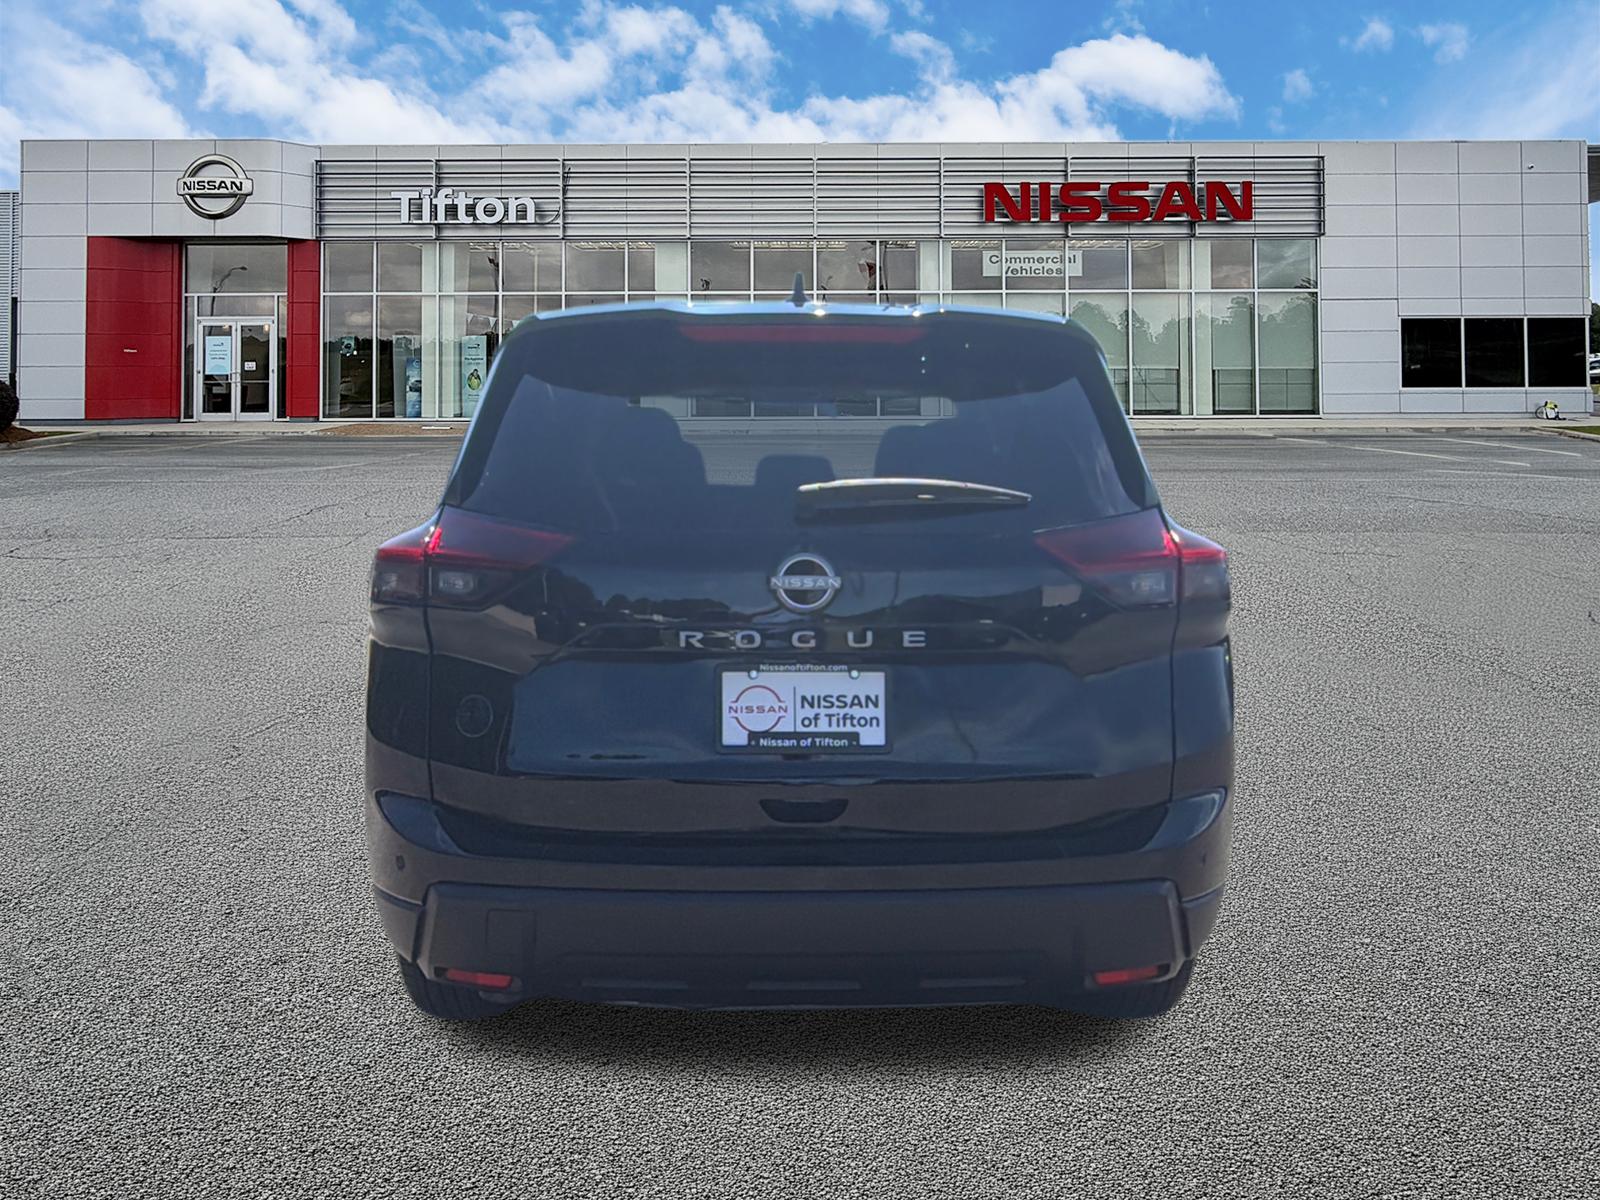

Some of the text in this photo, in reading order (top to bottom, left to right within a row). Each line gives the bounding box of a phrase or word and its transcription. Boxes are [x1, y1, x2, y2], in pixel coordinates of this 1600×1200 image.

[183, 180, 243, 191] NISSAN
[391, 187, 536, 224] Tifton
[983, 180, 1253, 223] NISSAN
[989, 254, 1077, 265] Cmmercil
[770, 577, 841, 589] NISSAN
[678, 630, 927, 648] ROGUE
[800, 694, 880, 710] NISSAN
[728, 705, 789, 714] NISSAN
[801, 712, 880, 728] of Tifton
[759, 738, 849, 748] Nissan of Tifton
